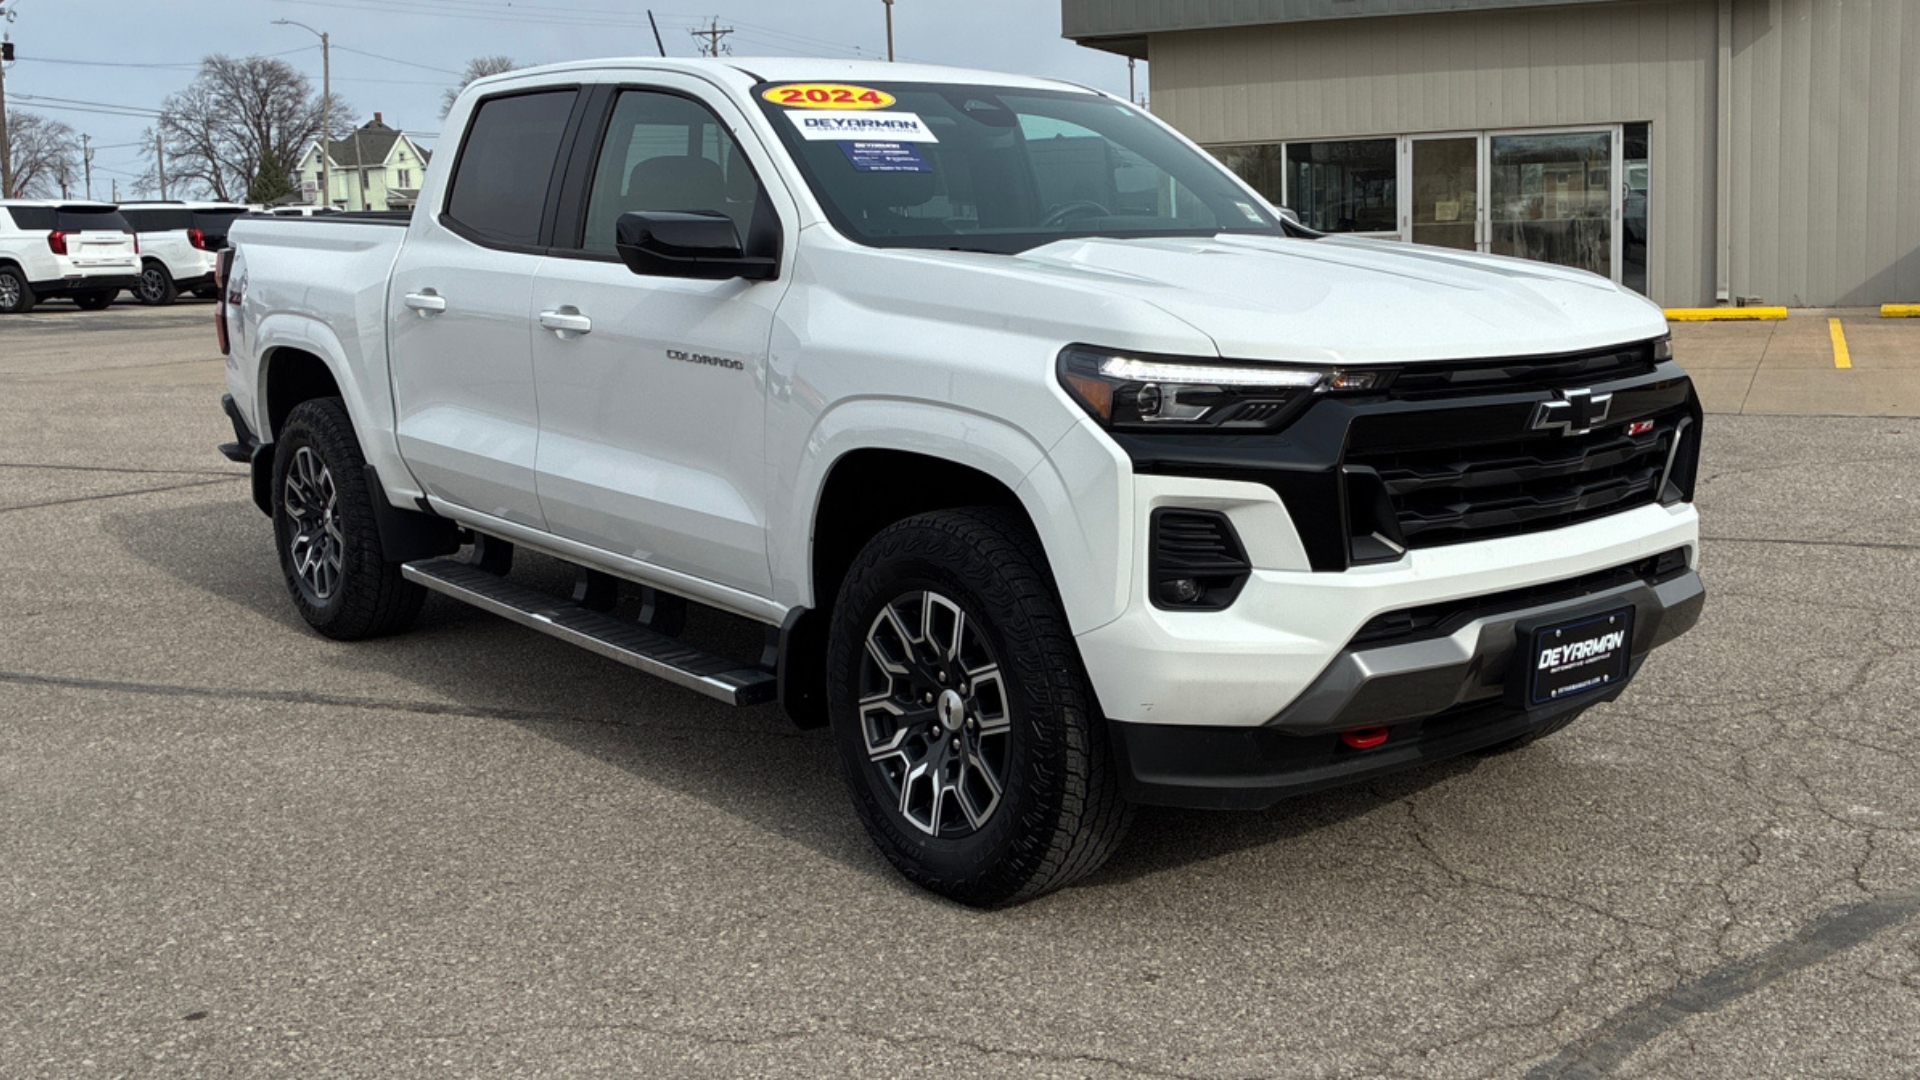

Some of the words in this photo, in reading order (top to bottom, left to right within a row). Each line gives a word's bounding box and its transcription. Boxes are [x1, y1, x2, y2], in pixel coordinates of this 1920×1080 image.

[780, 89, 883, 104] 2024
[804, 118, 918, 130] DEYARMAN
[666, 349, 744, 370] COLORADO
[1538, 629, 1625, 670] DEYARMAN
[874, 808, 924, 863] TERRITORY
